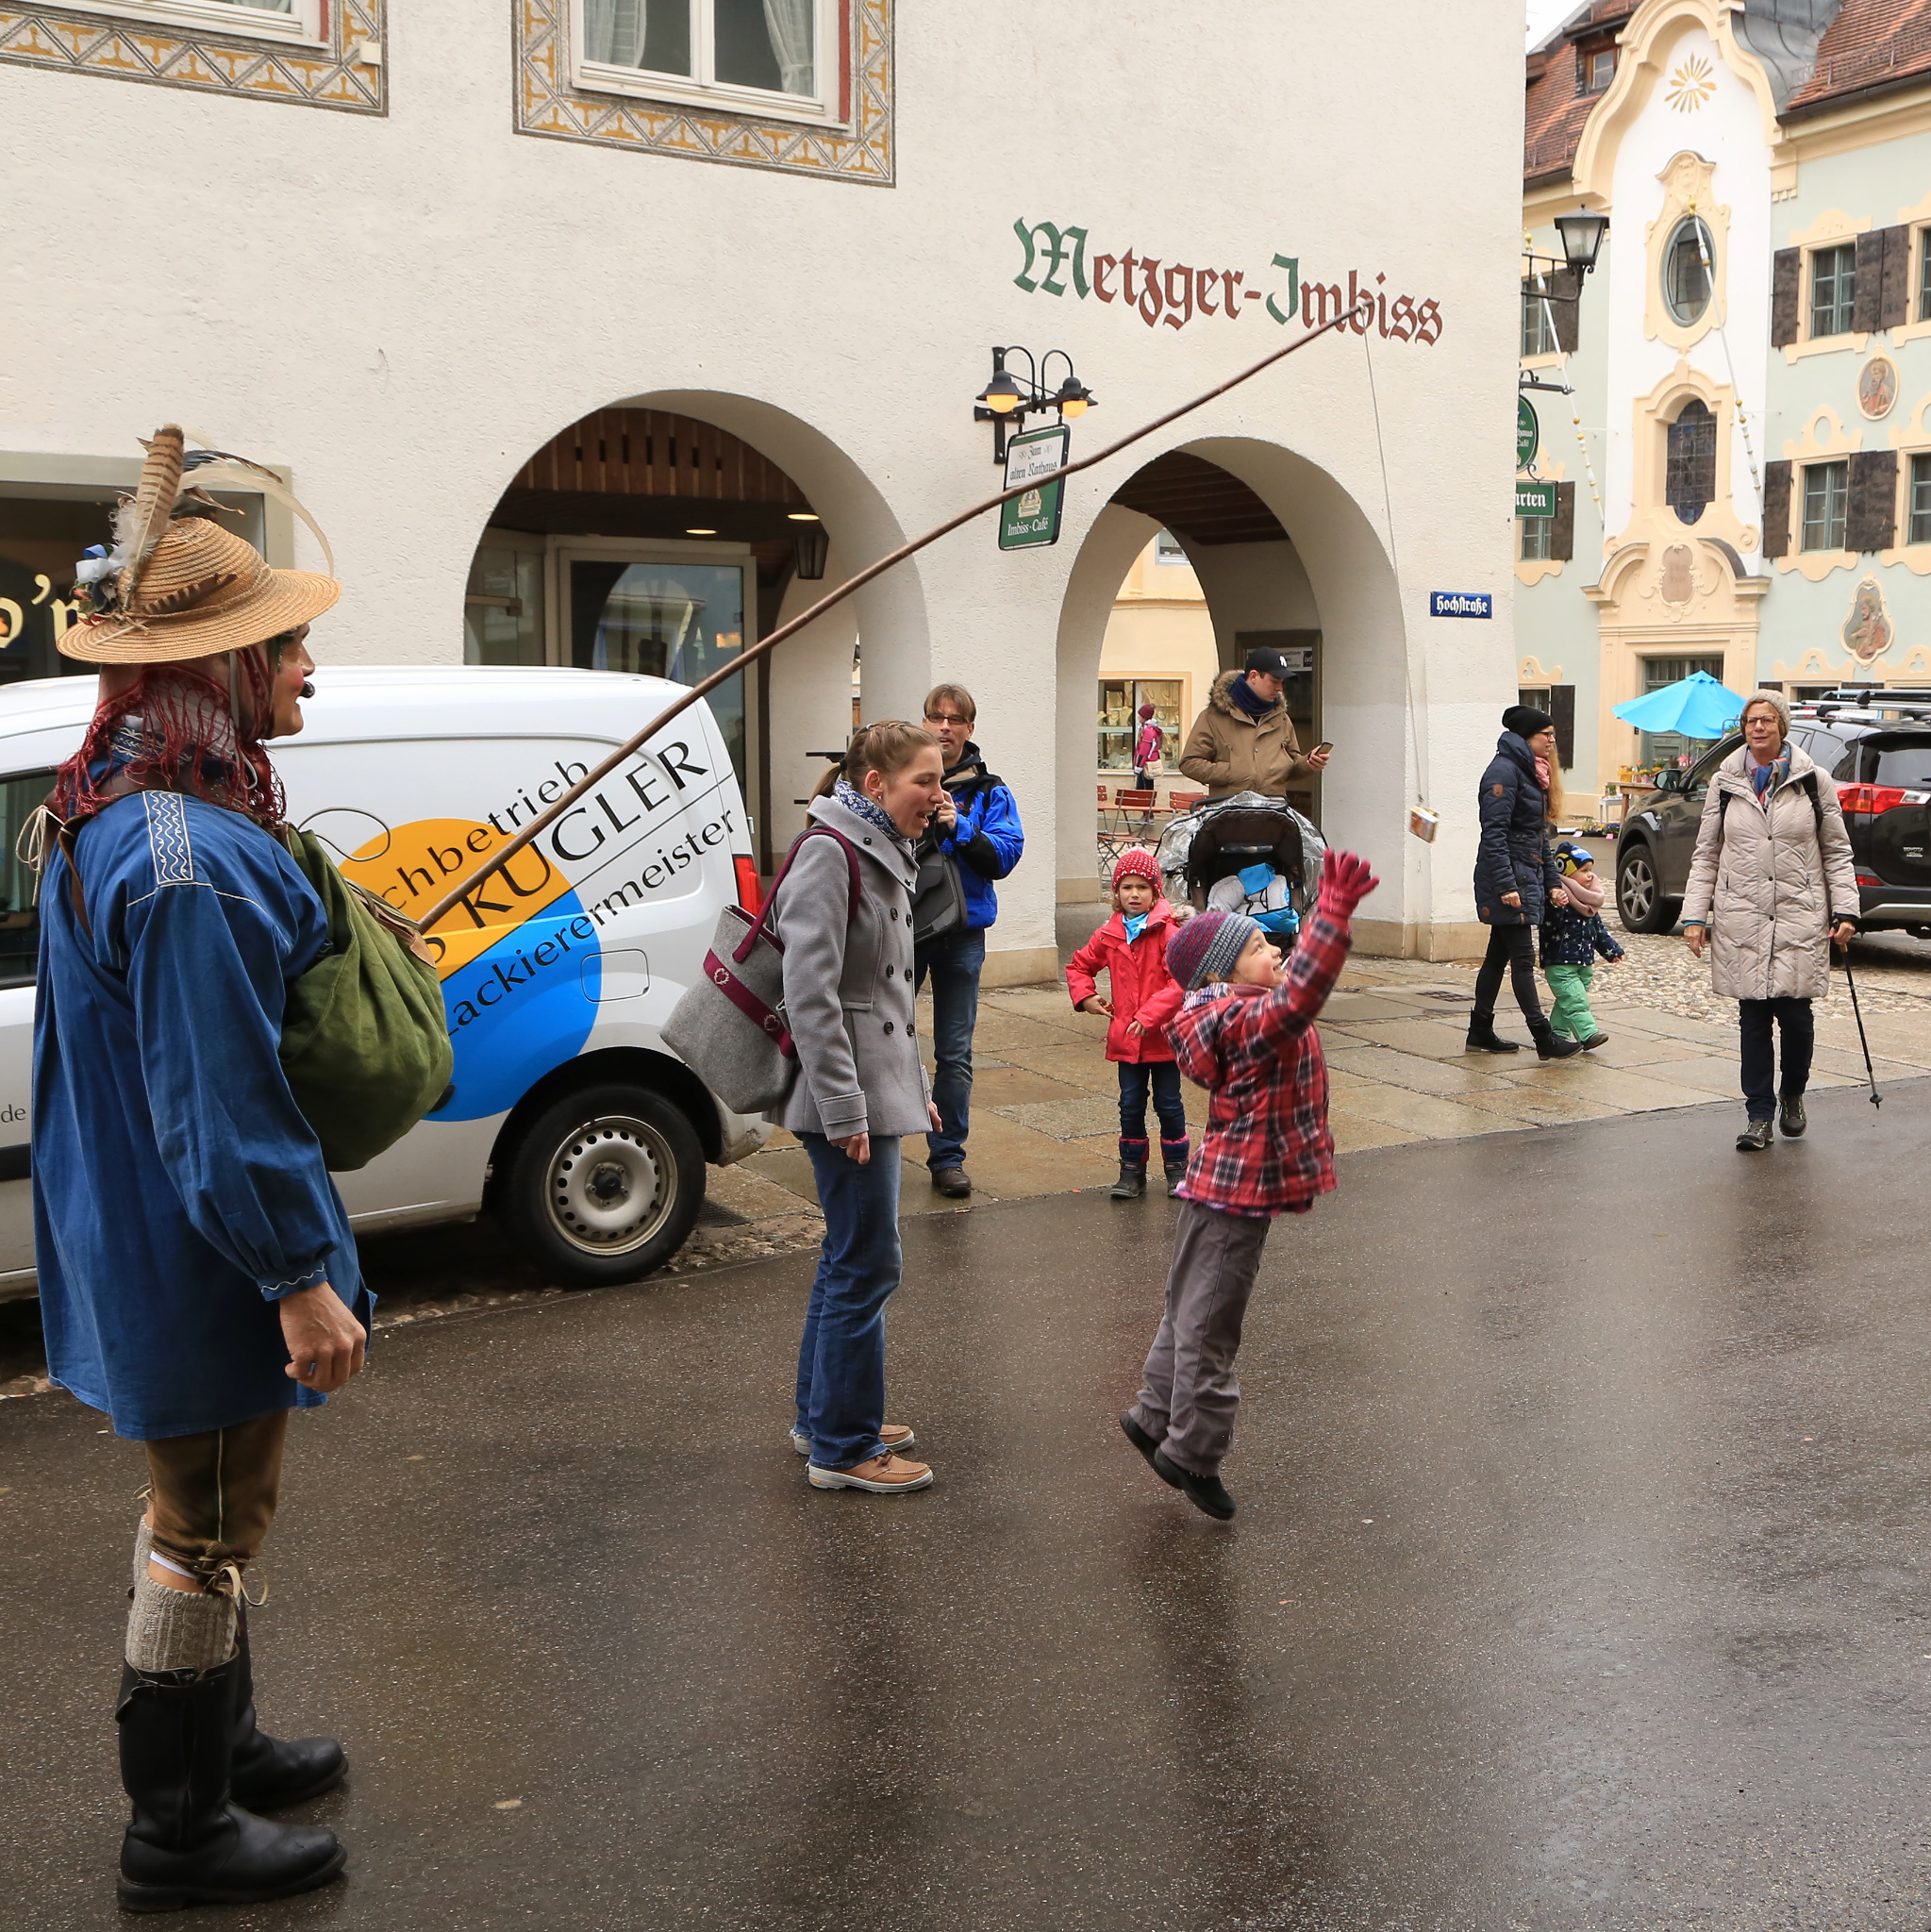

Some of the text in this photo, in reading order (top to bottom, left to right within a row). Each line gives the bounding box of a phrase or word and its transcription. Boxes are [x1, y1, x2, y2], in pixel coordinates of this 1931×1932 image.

[1012, 216, 1443, 347] Metzger-Imbiss
[1027, 461, 1057, 476] Rathaus
[459, 741, 709, 928] KUGLER
[447, 808, 736, 1037] ackierermeister
